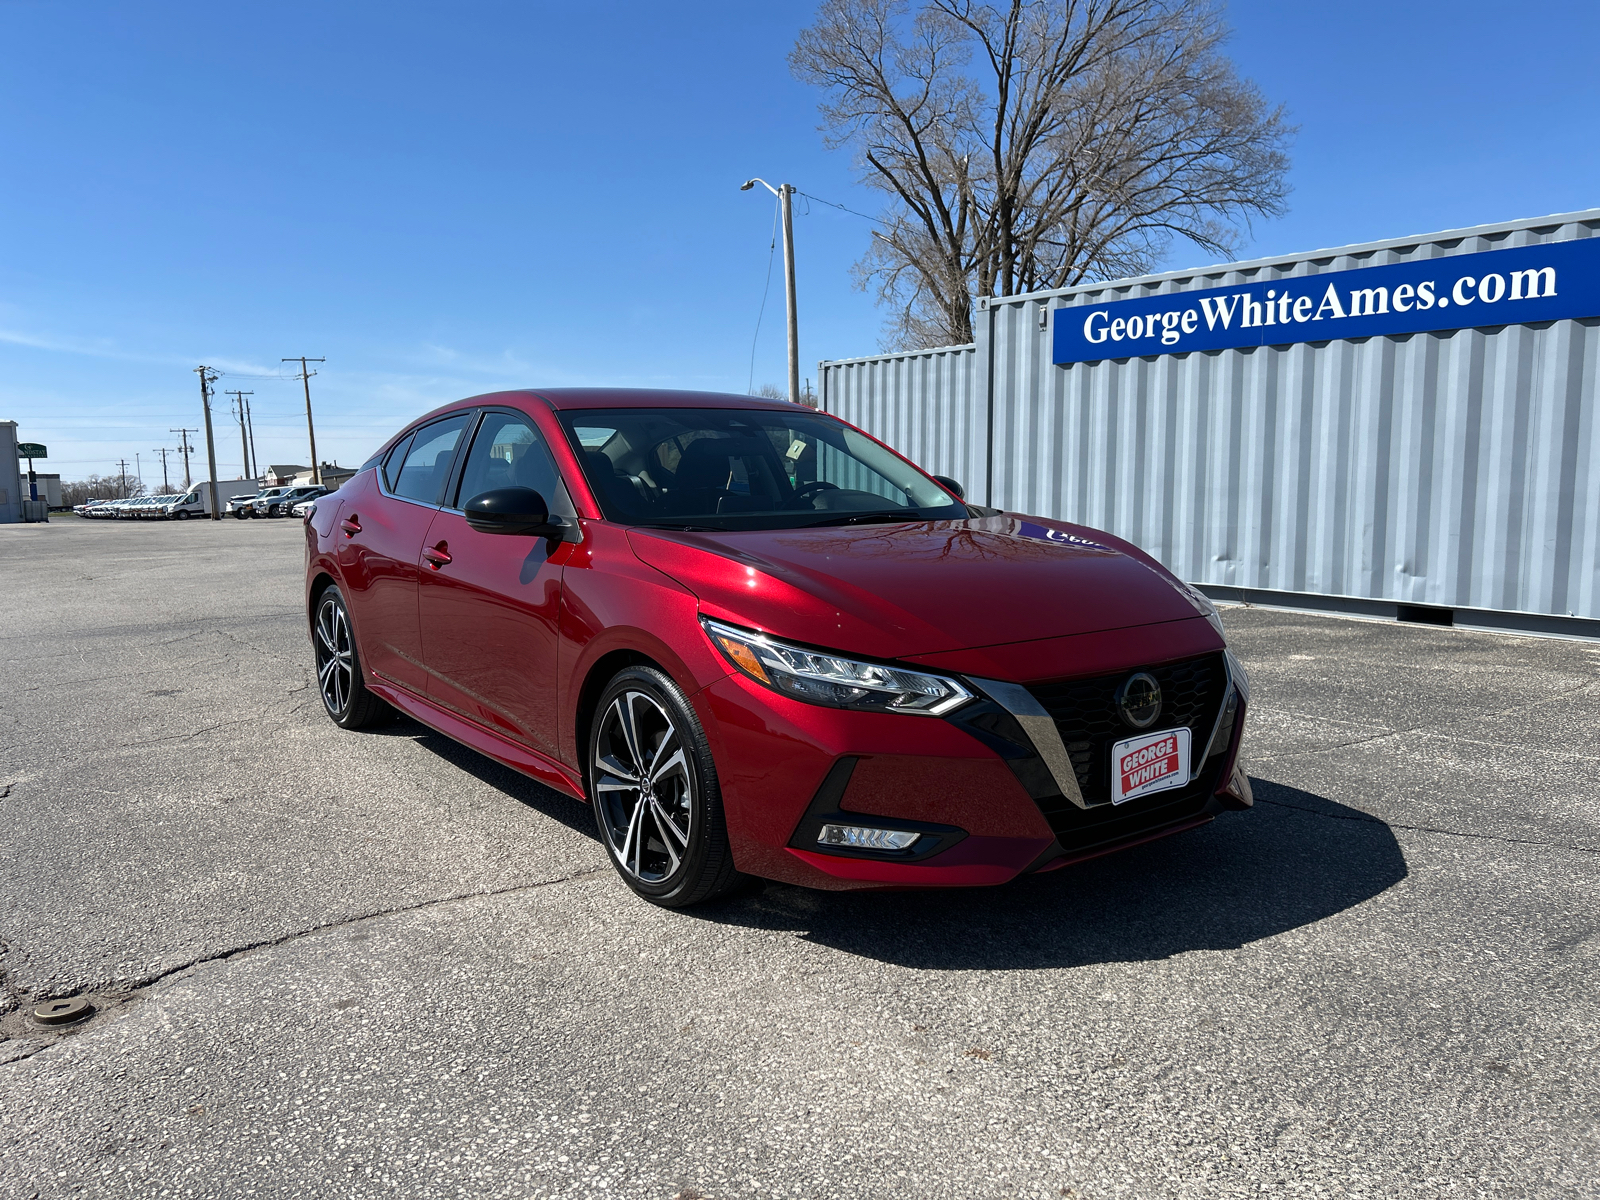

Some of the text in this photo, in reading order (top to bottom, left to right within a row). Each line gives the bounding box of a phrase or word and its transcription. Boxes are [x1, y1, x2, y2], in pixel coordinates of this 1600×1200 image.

[1083, 266, 1557, 345] GeorgeWhiteAmes.com
[1123, 738, 1174, 772] GEORGE
[1129, 759, 1168, 788] WHITE
